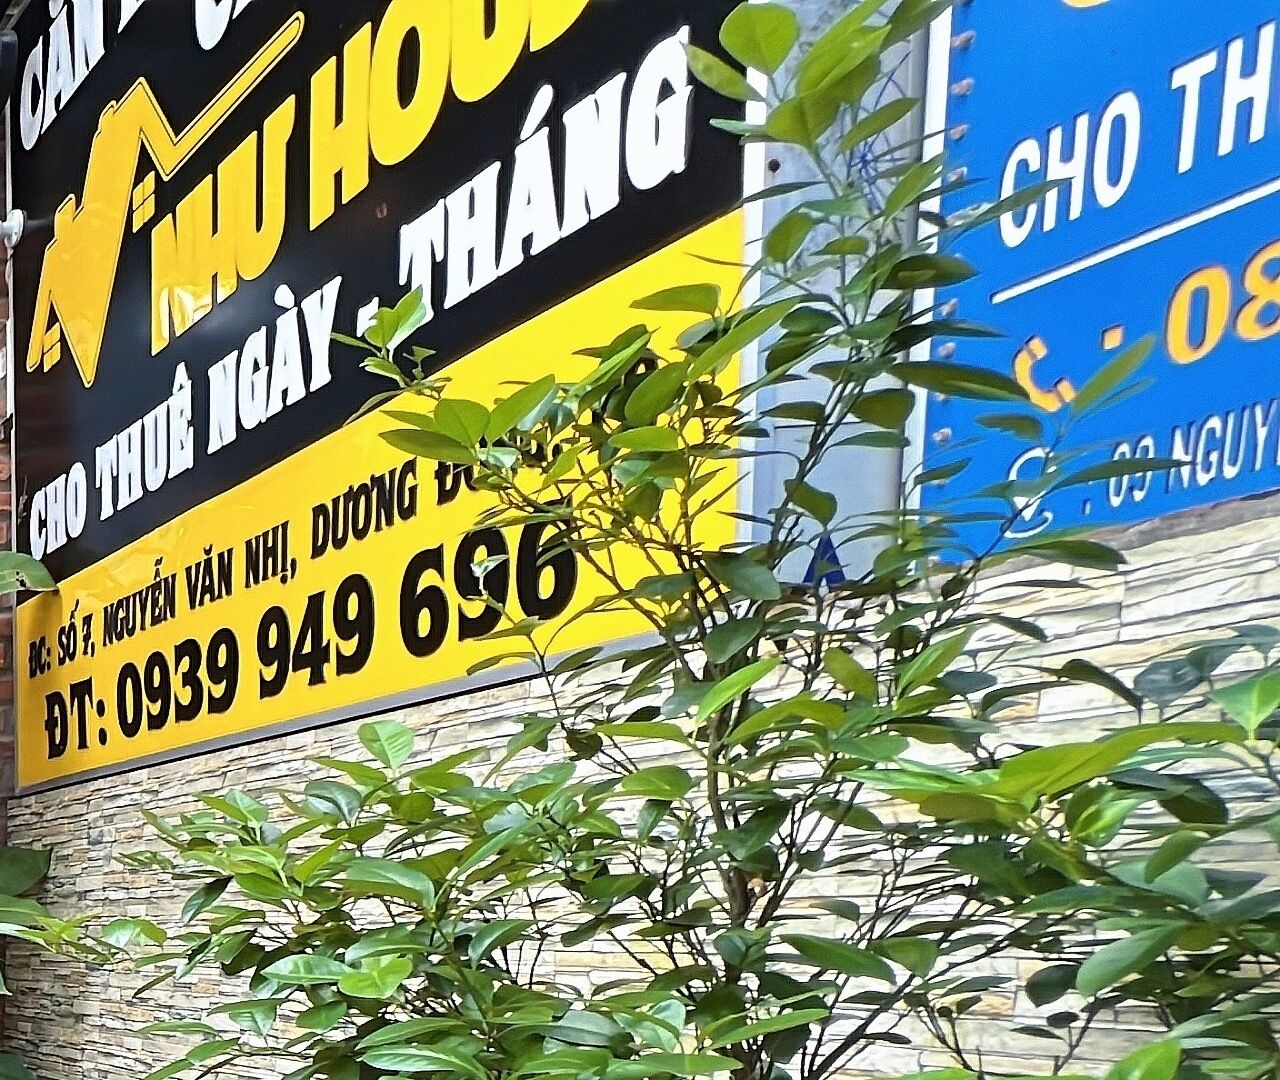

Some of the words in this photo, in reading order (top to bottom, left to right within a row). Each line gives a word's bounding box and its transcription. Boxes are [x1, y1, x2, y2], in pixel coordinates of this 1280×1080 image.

[310, 0, 595, 230] HOU
[999, 91, 1140, 248] CHO
[30, 462, 87, 560] CHO
[95, 362, 194, 521] THUÊ
[207, 279, 340, 455] NGÀY
[399, 25, 694, 327] THÁNG
[1167, 397, 1280, 495] NGUY
[28, 638, 52, 679] ĐC:
[57, 599, 80, 666] SỐ
[103, 556, 177, 648] NGUYỄN
[185, 544, 234, 610] VĂN
[244, 520, 297, 589] NHỊ,
[311, 456, 419, 559] DƯƠNG
[45, 677, 108, 760] ĐT:
[116, 627, 239, 738] 0939
[257, 573, 375, 700] 949
[400, 495, 578, 658] 696
